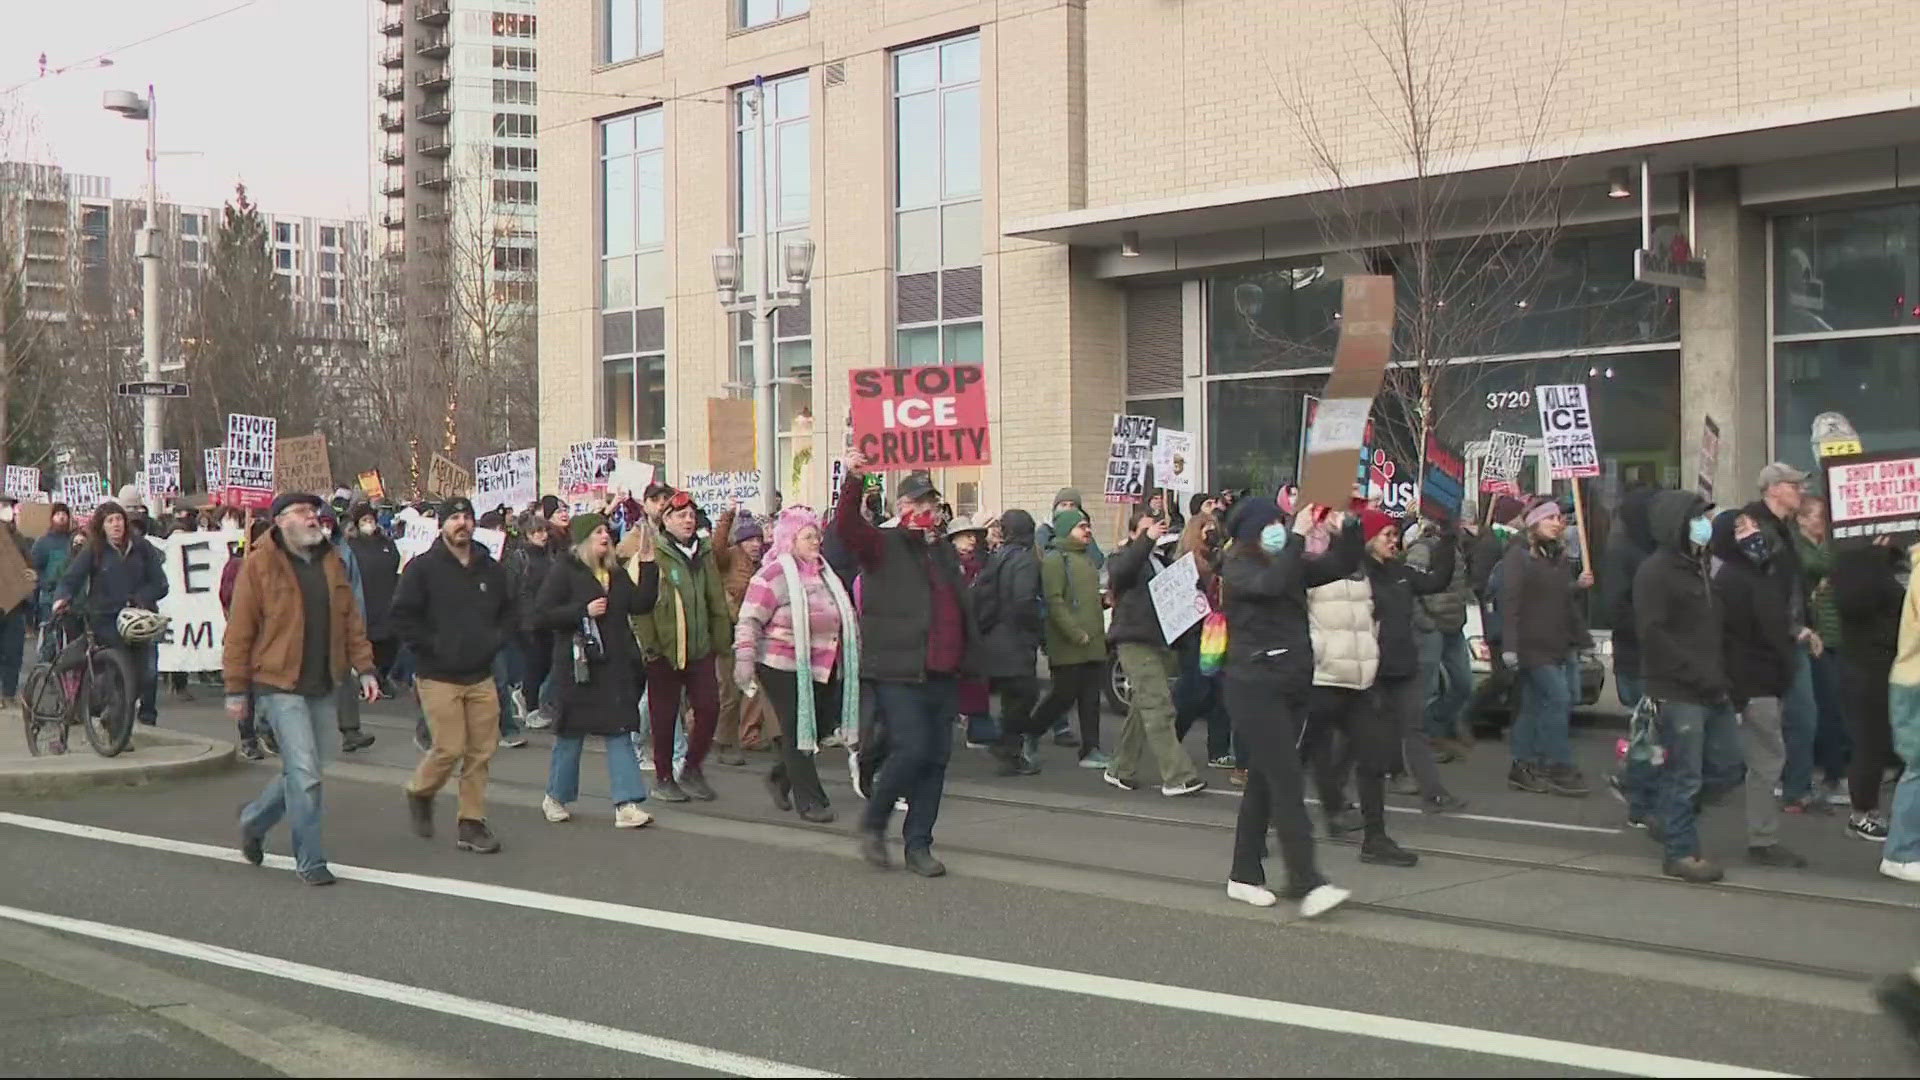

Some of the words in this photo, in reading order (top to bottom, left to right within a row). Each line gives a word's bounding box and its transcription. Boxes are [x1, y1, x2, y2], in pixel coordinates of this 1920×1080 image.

[855, 366, 982, 397] STOP
[1486, 391, 1529, 409] 3720
[1545, 387, 1581, 408] KILLER
[883, 397, 957, 428] ICE
[1543, 409, 1588, 432] ICE
[231, 416, 274, 436] REVOKE
[1114, 416, 1153, 440] JUSTICE
[231, 434, 251, 449] THE
[256, 437, 273, 452] ICE
[596, 441, 617, 449] JAIL
[861, 427, 986, 466] CRUELTY
[229, 450, 273, 469] PERMIT
[477, 454, 511, 474] REVOKE
[1549, 443, 1594, 467] STREETS
[478, 469, 520, 492] PERMIT!
[1846, 466, 1874, 482] SHUT
[1880, 462, 1914, 478] DOWN
[717, 486, 760, 498] AMRICA
[1838, 483, 1859, 500] THE
[703, 501, 744, 515] GRET
[1847, 501, 1864, 516] ICE
[1869, 495, 1919, 513] FACILITY
